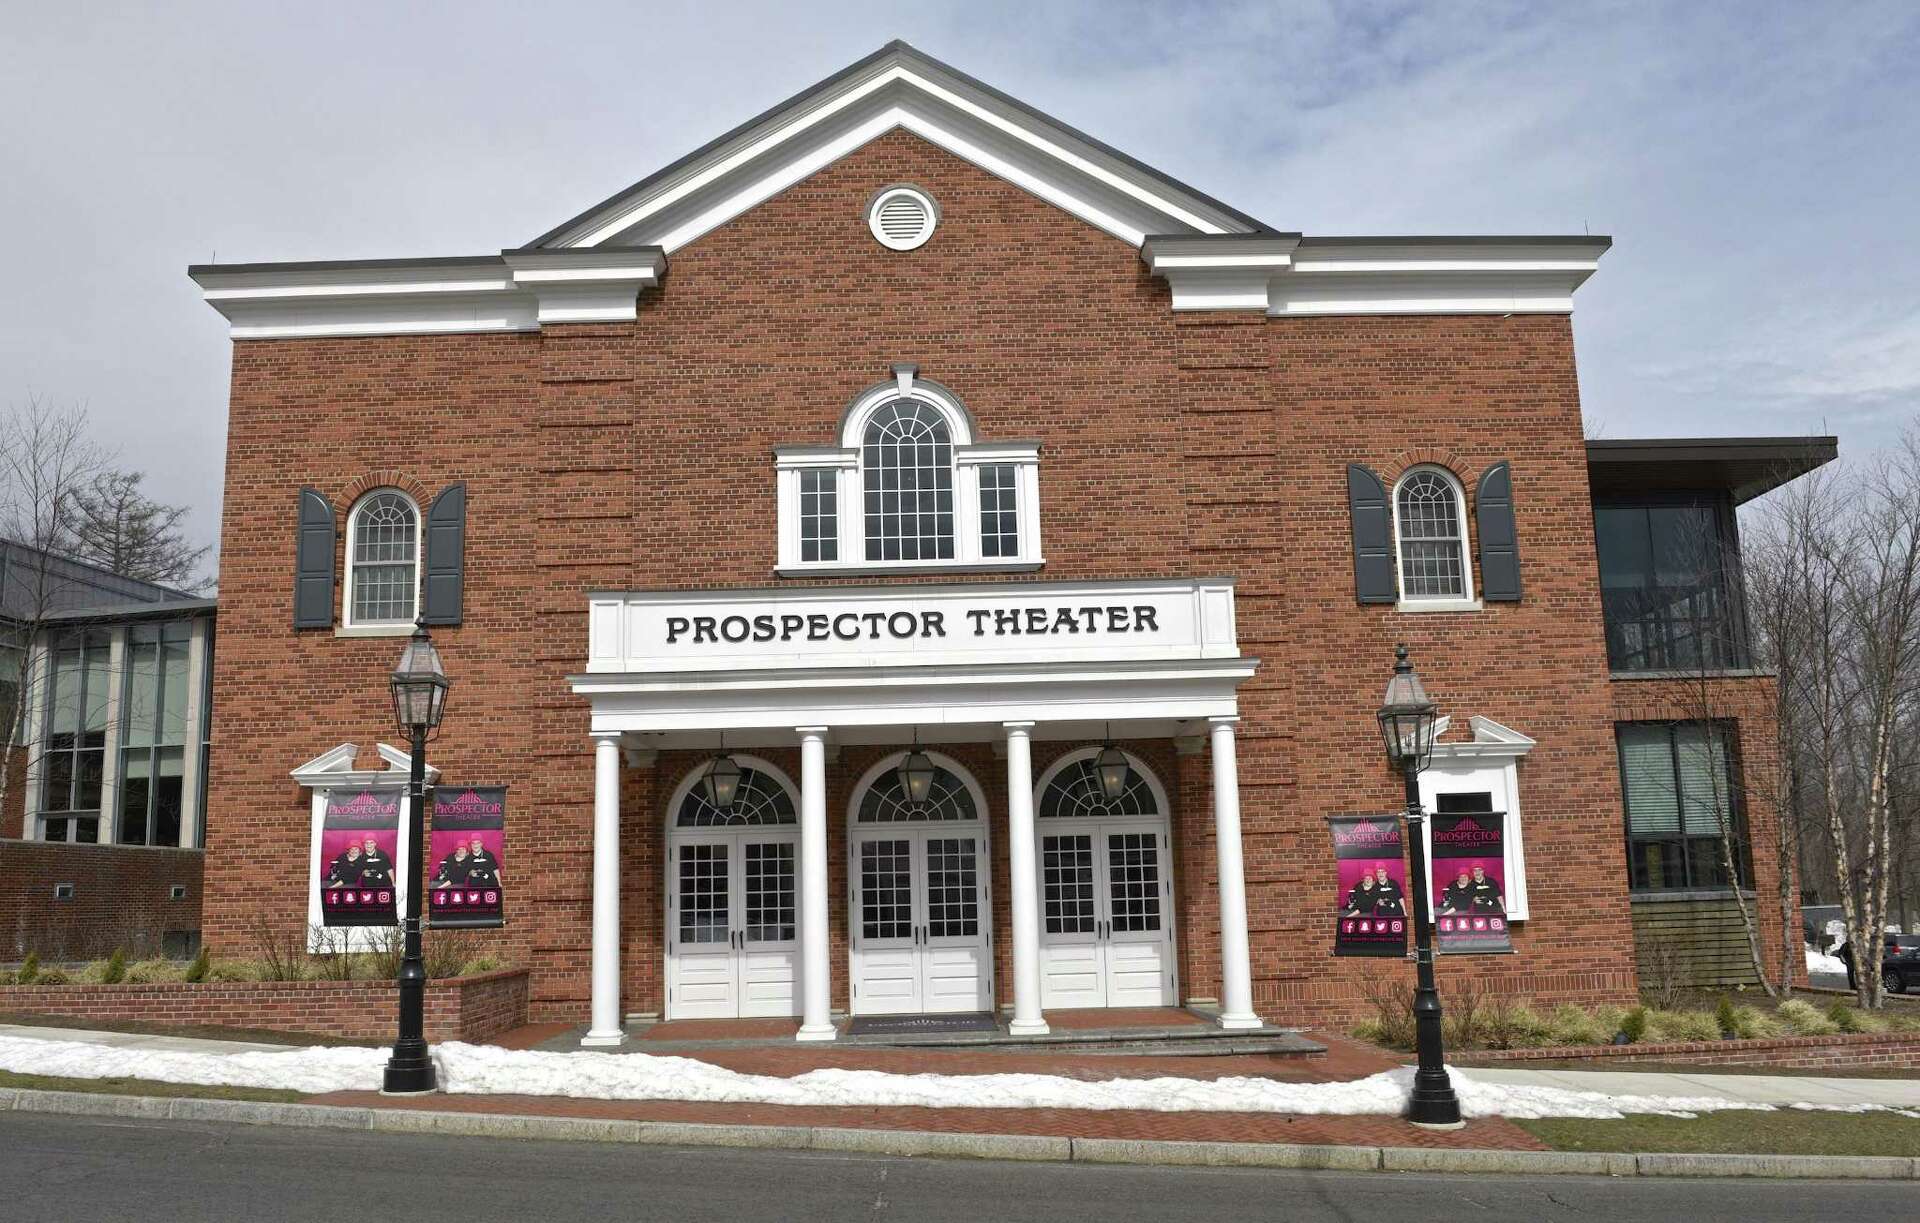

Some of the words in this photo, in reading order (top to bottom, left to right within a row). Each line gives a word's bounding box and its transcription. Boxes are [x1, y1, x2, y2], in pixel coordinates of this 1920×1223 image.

[666, 610, 946, 643] PROSPECTOR
[966, 605, 1159, 636] THEATER
[328, 803, 397, 815] PROSPECTOR
[434, 802, 502, 815] PROSPECTOR
[1334, 831, 1400, 843] PROSPECTOR
[1434, 830, 1500, 842] PROSPECTOR
